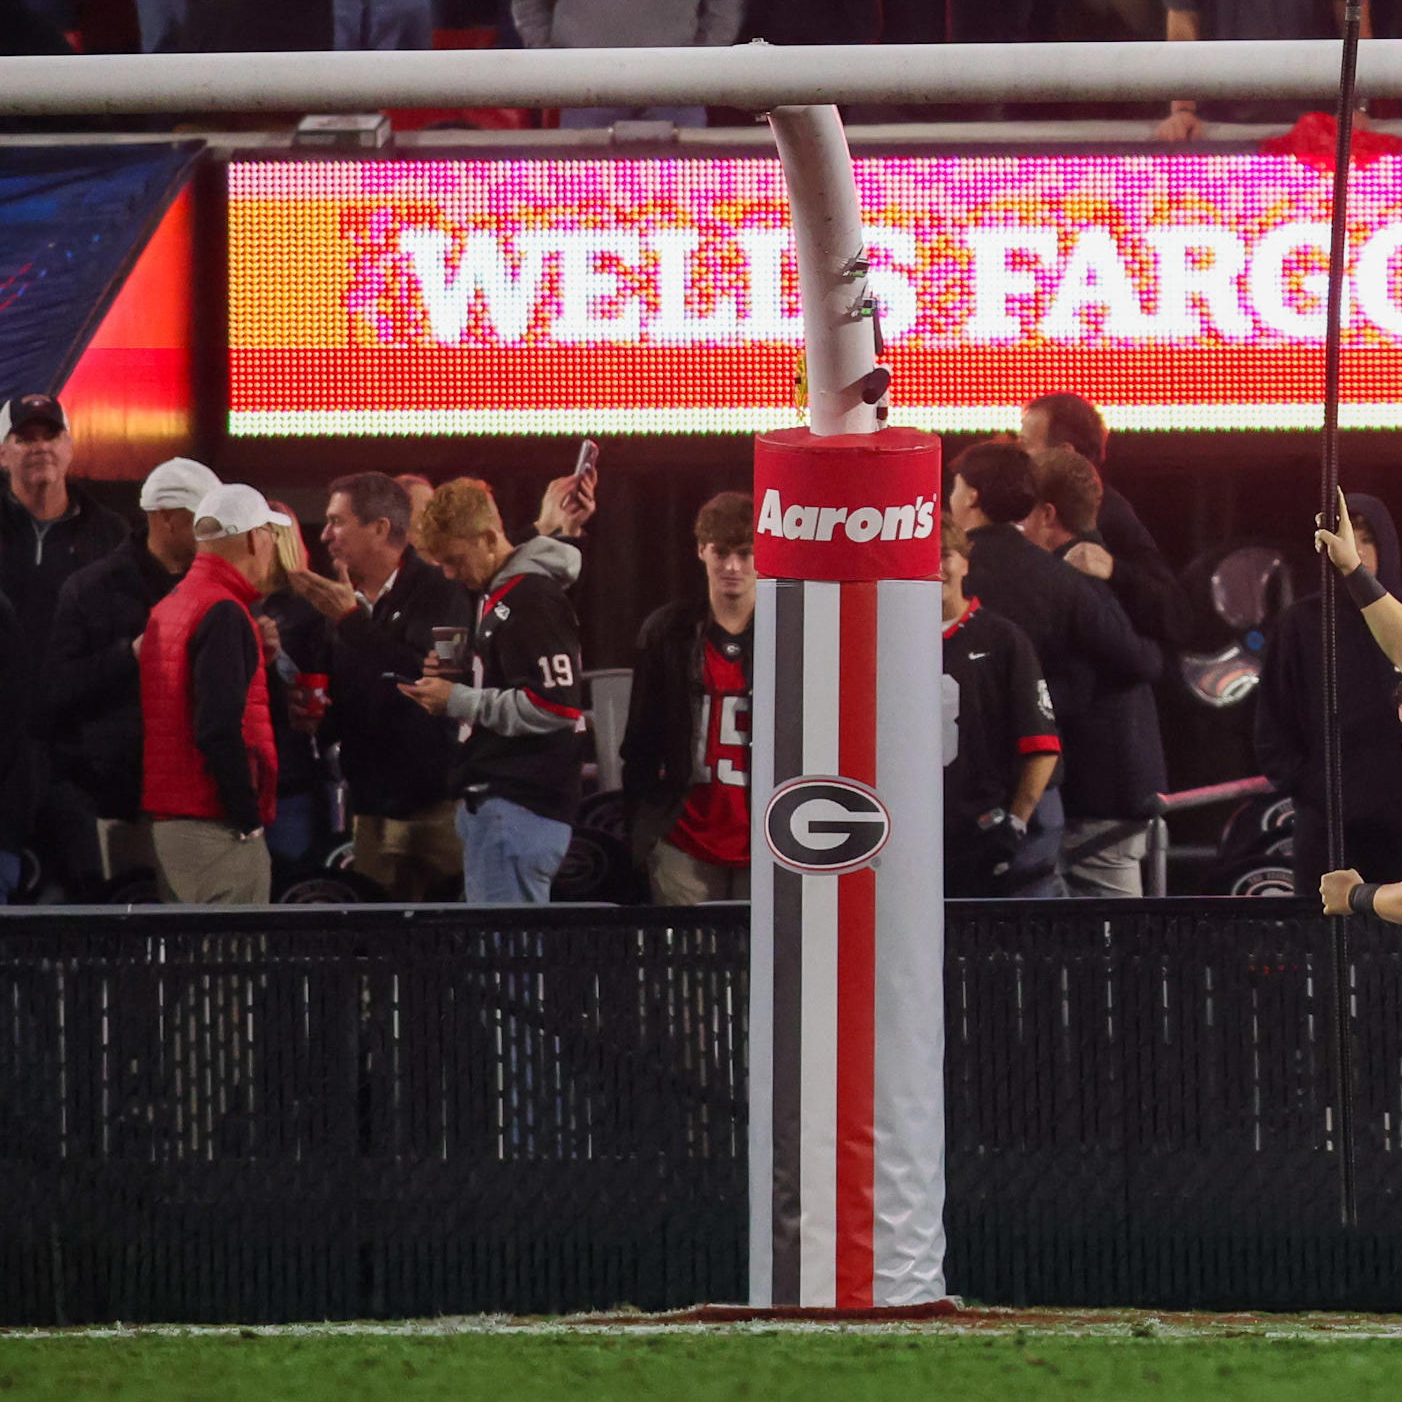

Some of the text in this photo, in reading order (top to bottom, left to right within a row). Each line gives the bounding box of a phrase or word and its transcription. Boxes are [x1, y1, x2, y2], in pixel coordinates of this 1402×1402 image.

[400, 226, 918, 344] WELLS
[757, 488, 935, 543] Aaron's
[537, 653, 574, 689] 19
